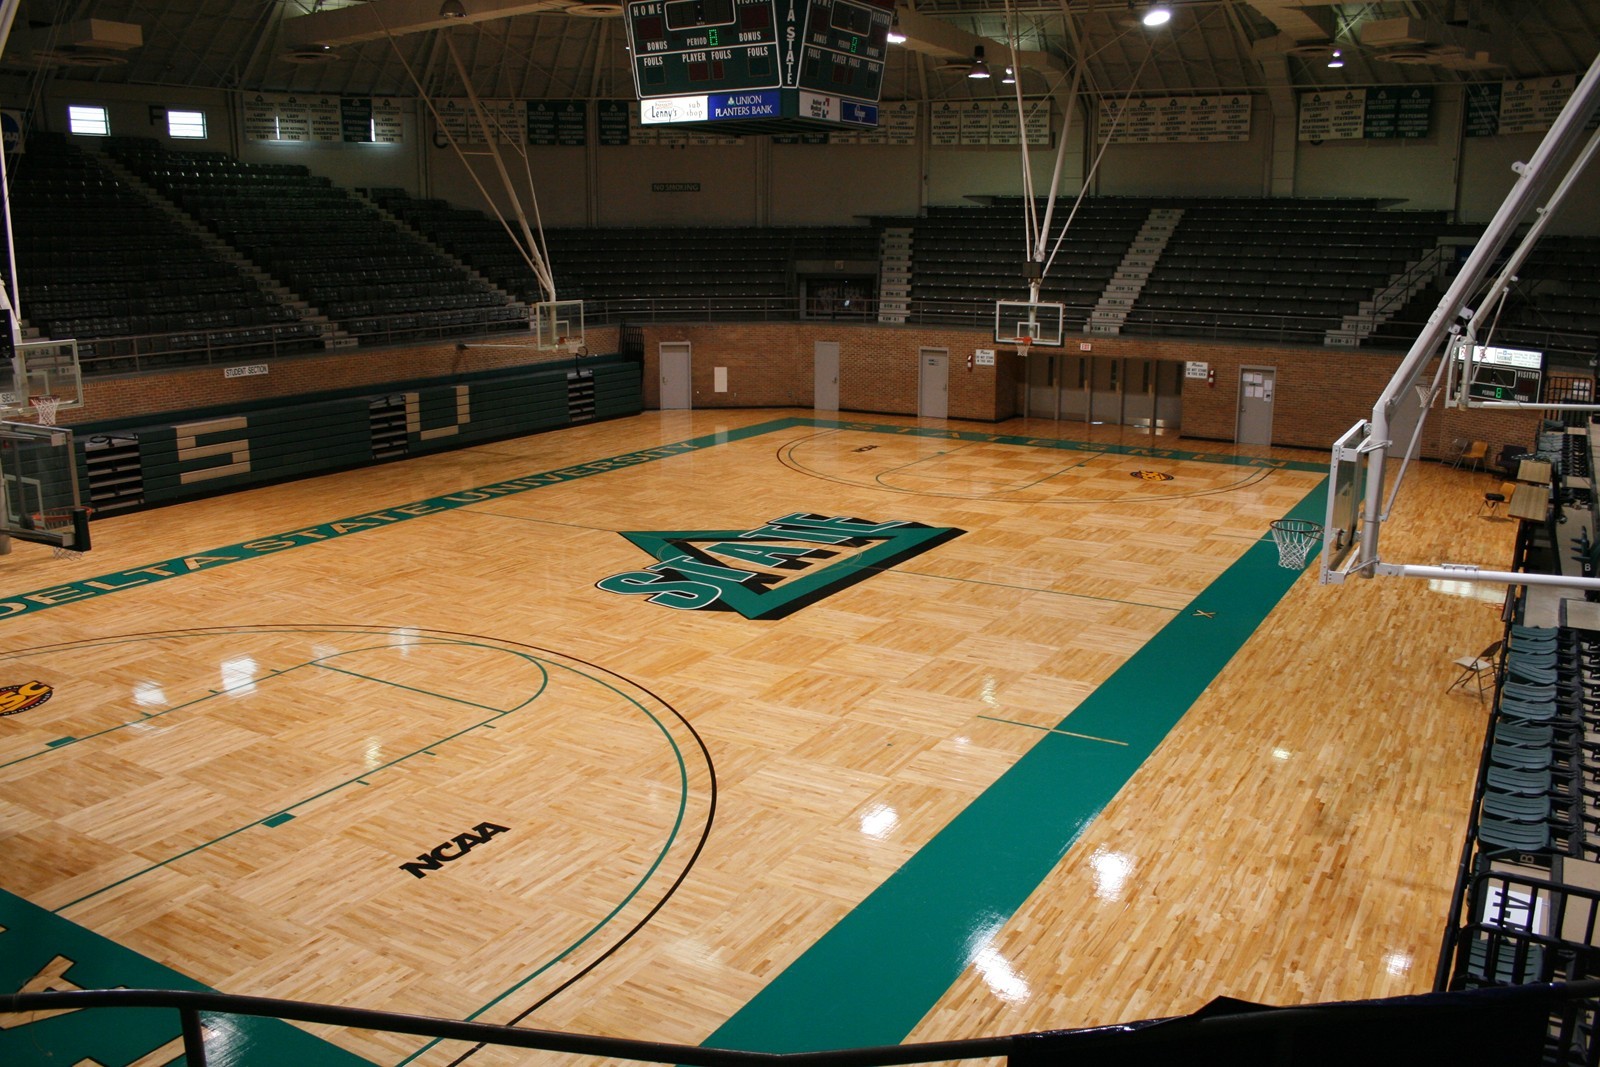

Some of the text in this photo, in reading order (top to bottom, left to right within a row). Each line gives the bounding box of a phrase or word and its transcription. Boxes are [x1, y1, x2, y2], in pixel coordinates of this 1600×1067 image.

[633, 4, 662, 16] HOME
[647, 31, 762, 51] BONUS PERIOD BONUS
[644, 46, 768, 66] FOULS PLAYER FOULS FOULS
[786, 26, 796, 84] STATE
[736, 96, 762, 105] UNION
[652, 106, 677, 122] Lenny's
[716, 105, 772, 117] PLANTERS BANK
[226, 366, 267, 376] STUDENT SECTION
[1518, 371, 1539, 380] VISITOR
[241, 500, 445, 554] STATE
[442, 442, 699, 503] UNIVERSITY
[595, 511, 914, 610] STATE
[1584, 563, 1591, 572] B
[398, 822, 512, 879] NCAA
